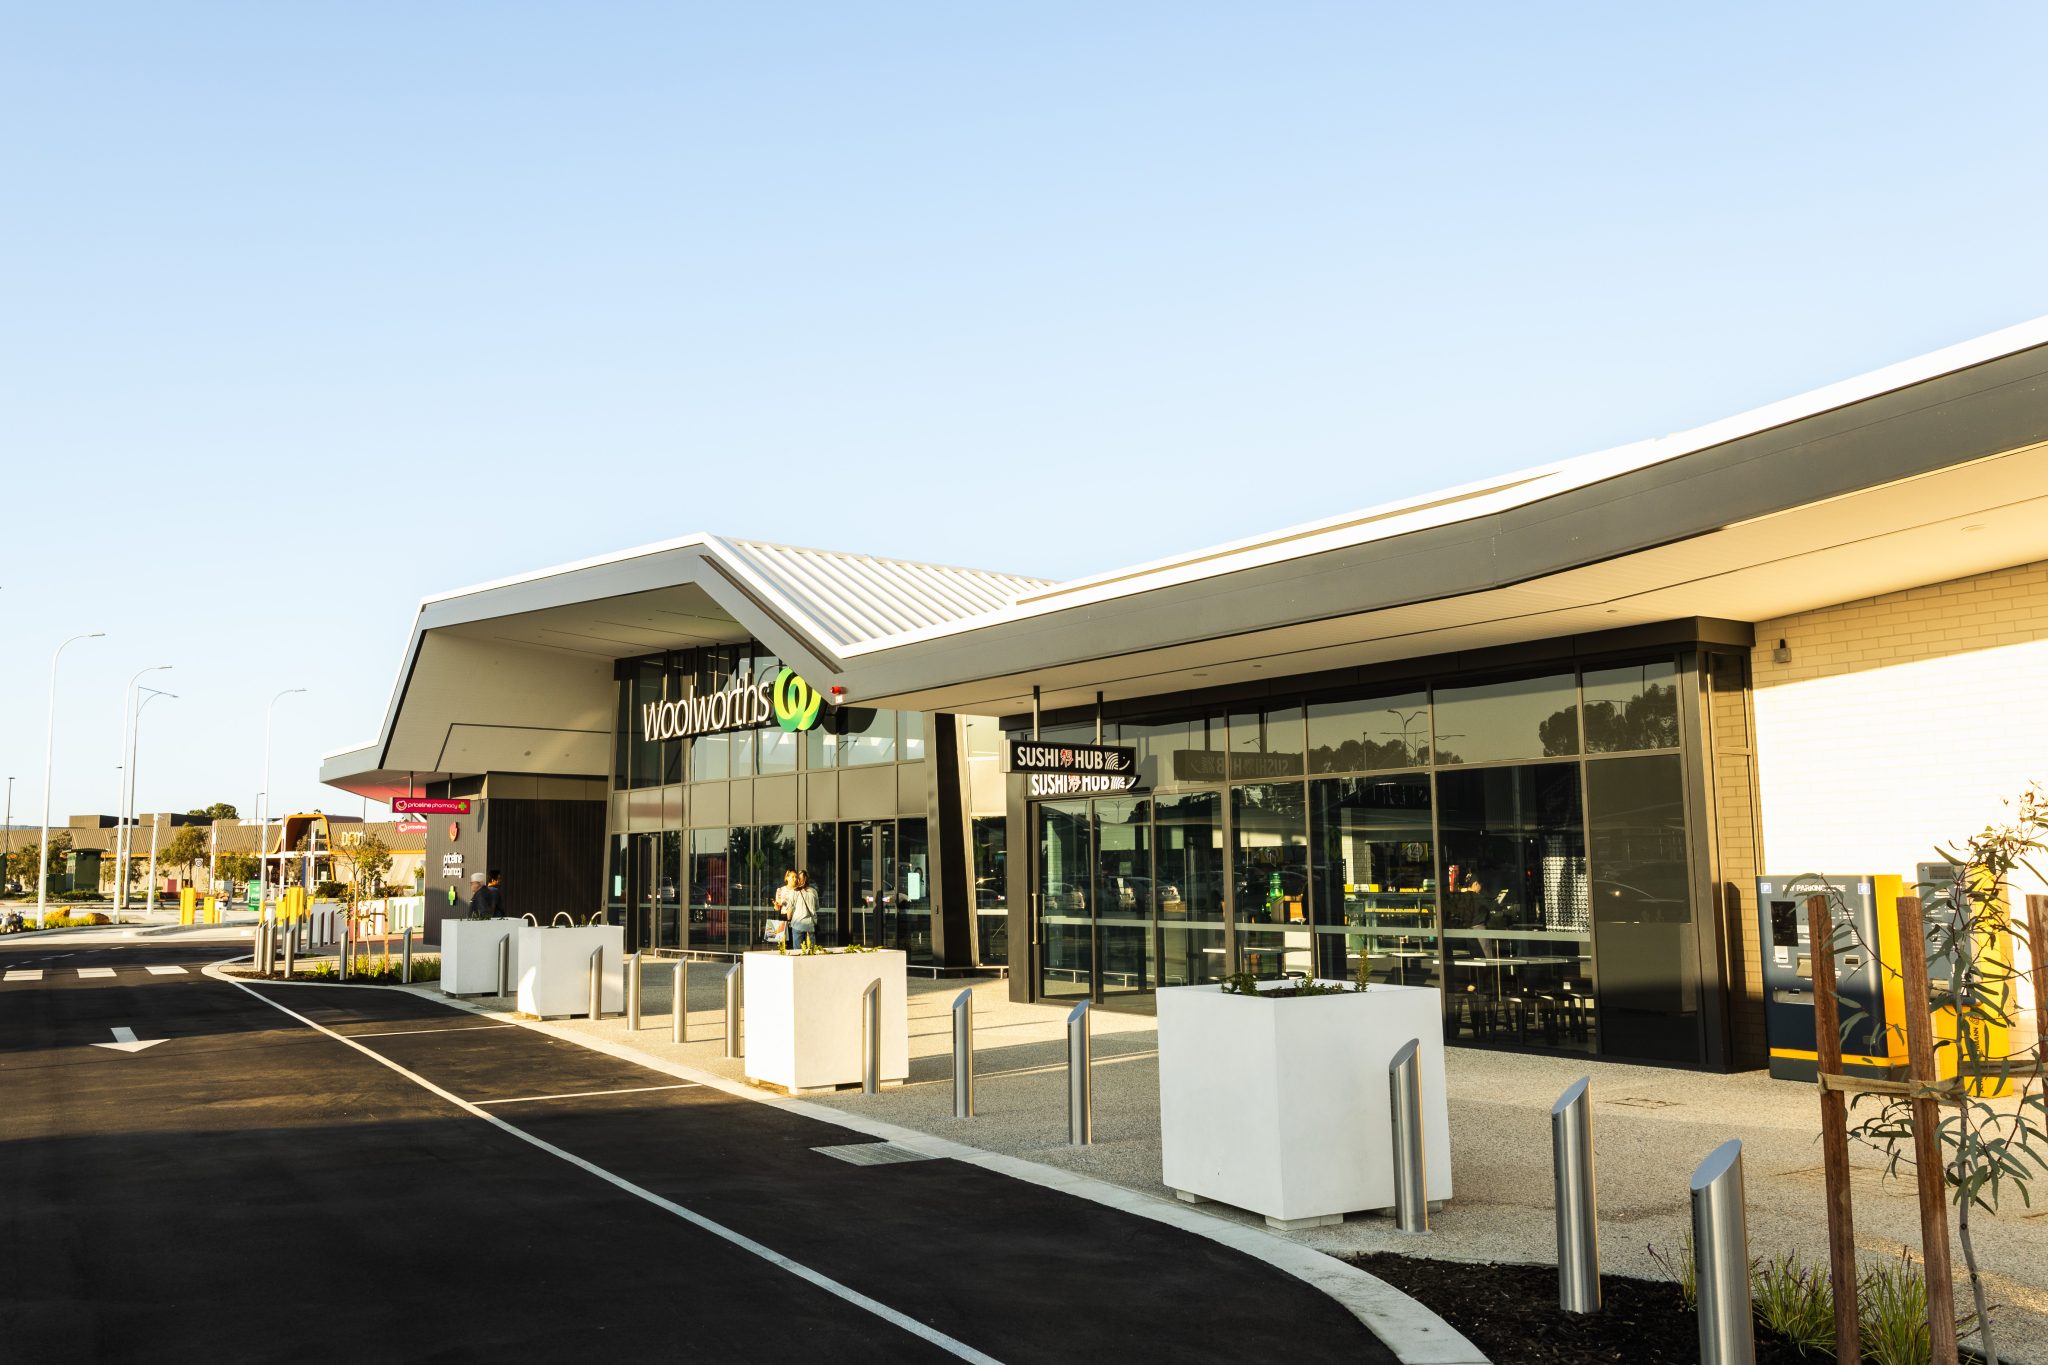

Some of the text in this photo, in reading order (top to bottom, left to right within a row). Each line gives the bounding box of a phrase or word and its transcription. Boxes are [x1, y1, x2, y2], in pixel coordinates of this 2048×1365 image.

[643, 672, 770, 742] woolworths
[1017, 746, 1059, 768] SUSHI
[1075, 749, 1103, 770] HUB
[1031, 774, 1068, 796] SUSHI
[407, 801, 458, 810] priceline pharmacy
